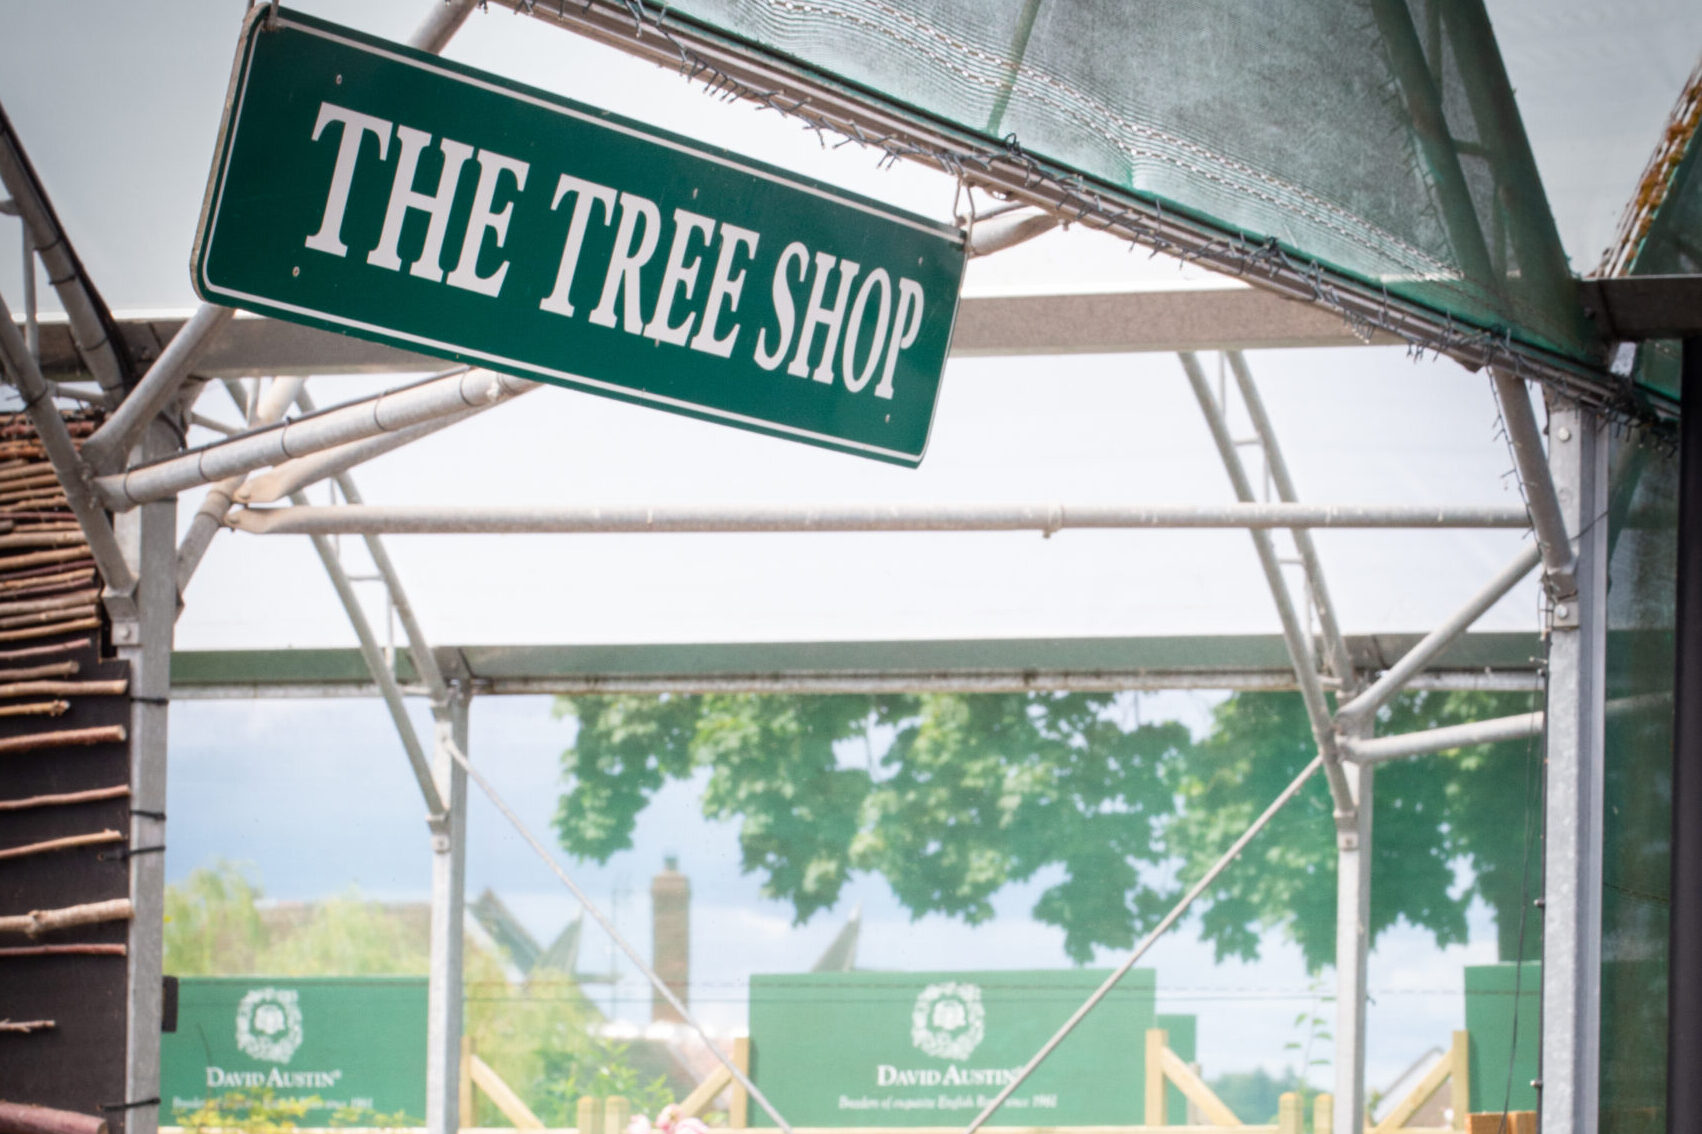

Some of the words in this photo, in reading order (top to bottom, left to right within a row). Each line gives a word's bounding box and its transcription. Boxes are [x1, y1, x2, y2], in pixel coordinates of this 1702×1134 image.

[304, 102, 531, 298] THE
[538, 174, 760, 358] TREE
[755, 242, 926, 400] SHOP
[206, 1066, 265, 1088] DAVID
[877, 1064, 941, 1087] DAVID
